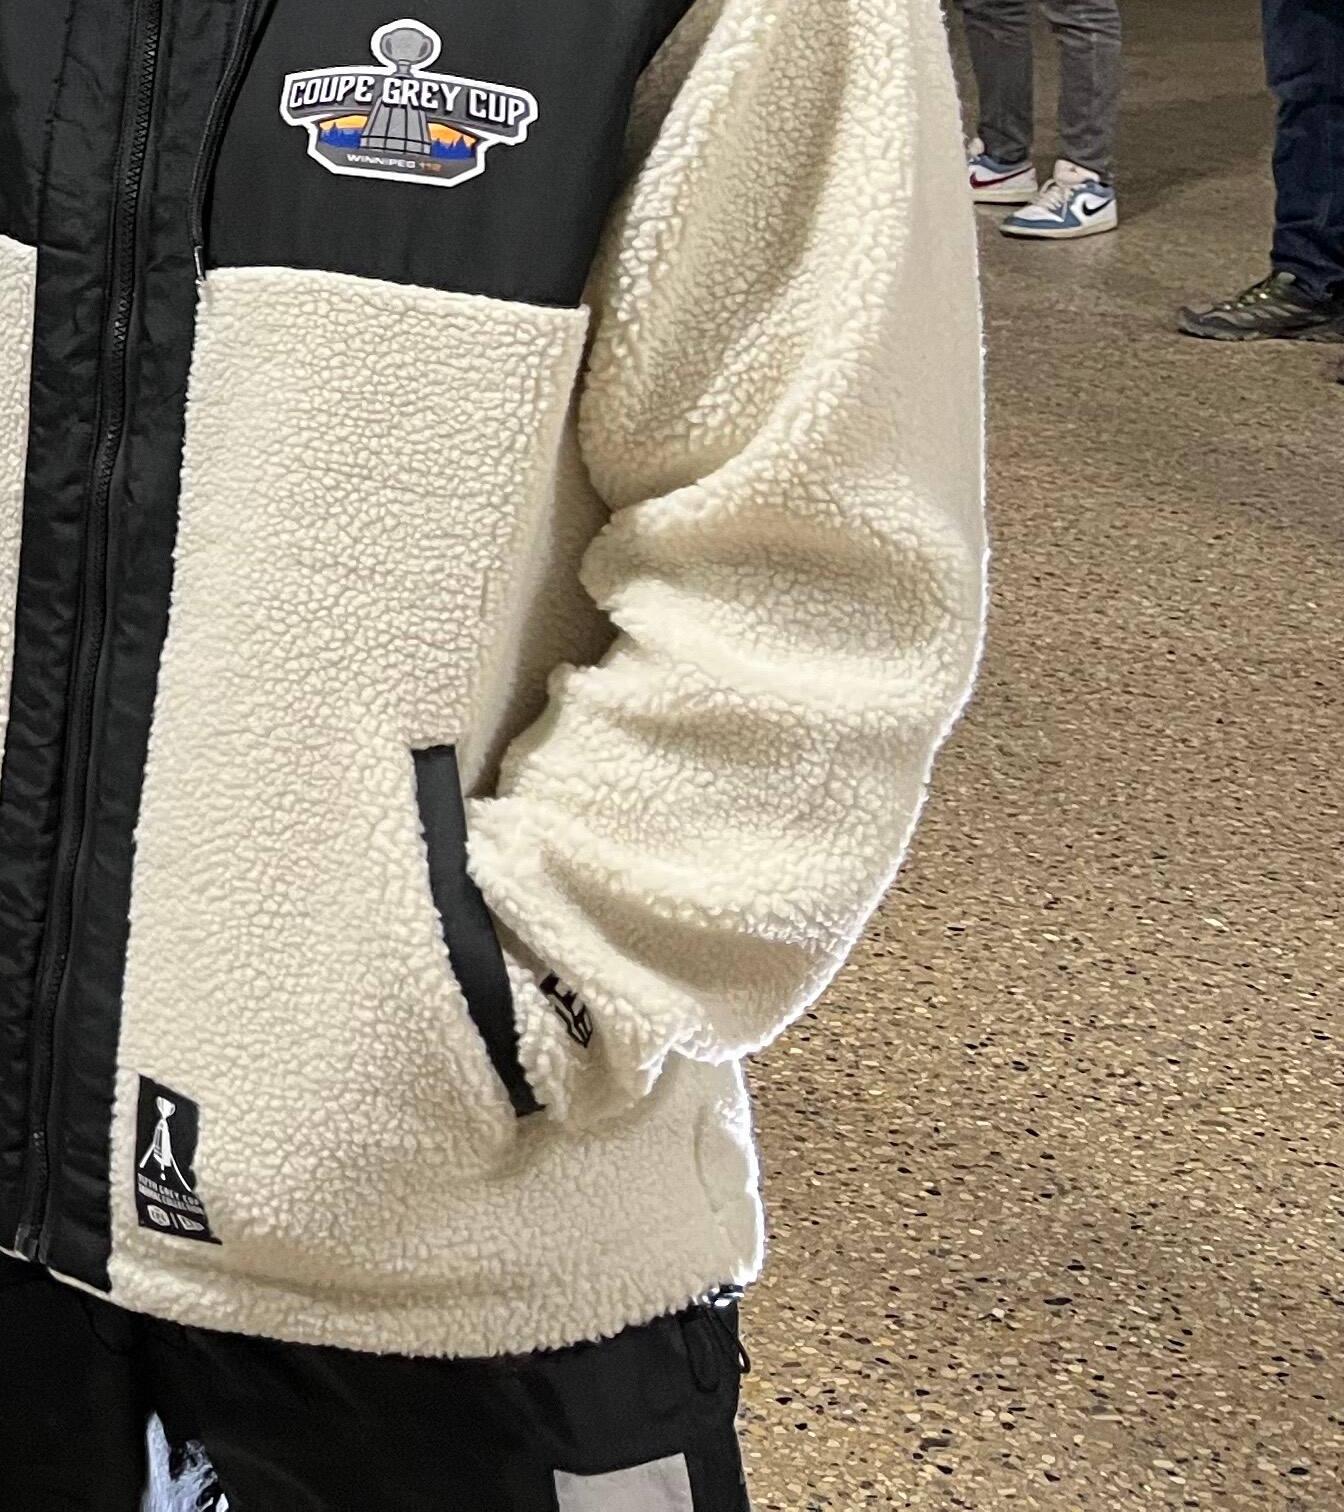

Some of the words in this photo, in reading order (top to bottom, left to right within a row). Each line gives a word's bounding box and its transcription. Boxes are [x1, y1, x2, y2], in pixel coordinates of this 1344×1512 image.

[289, 75, 376, 109] COUPE
[382, 76, 462, 112] GREY
[468, 89, 526, 126] CUP
[346, 152, 416, 169] WINNIPEG
